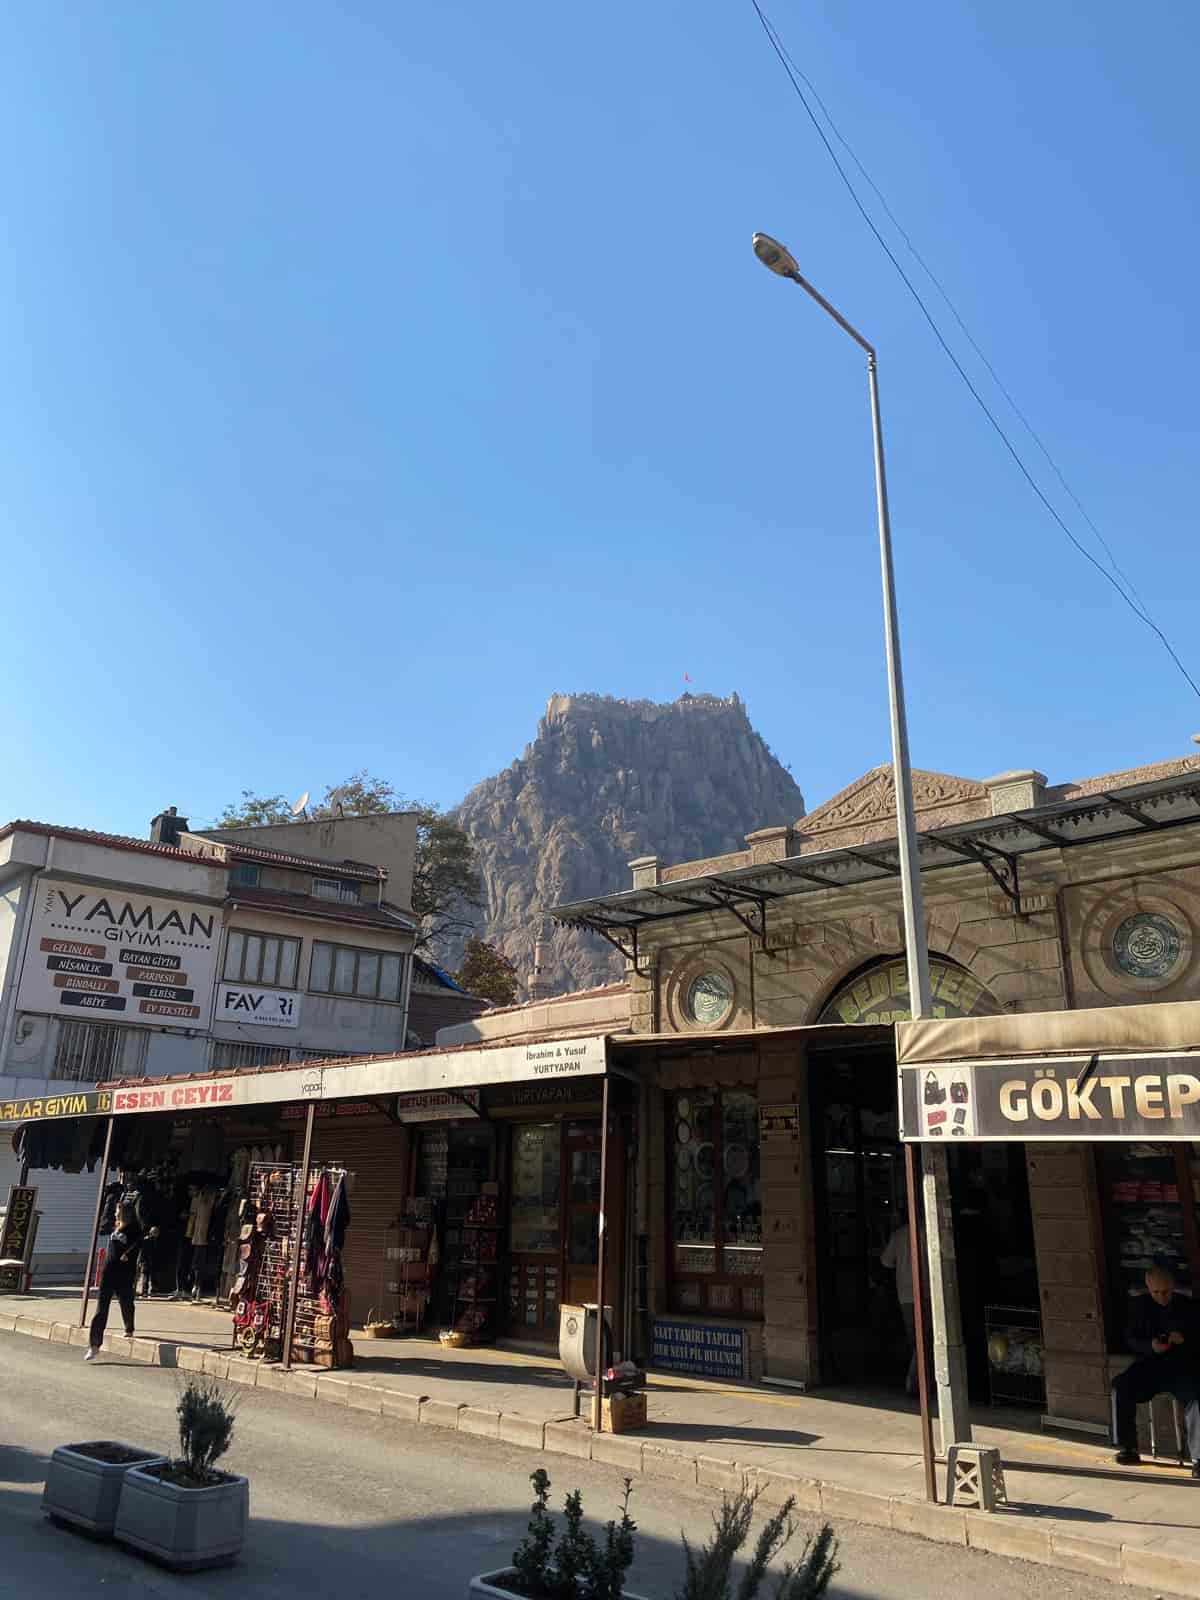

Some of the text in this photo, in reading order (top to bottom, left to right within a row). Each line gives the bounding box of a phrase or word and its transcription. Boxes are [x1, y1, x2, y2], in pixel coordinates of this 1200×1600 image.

[58, 890, 214, 939] YAMAN
[123, 952, 151, 964] BAYAN
[556, 1048, 562, 1057] &
[564, 1045, 586, 1057] Yusuf
[534, 1062, 581, 1074] YURTYAPAN
[115, 1091, 165, 1110] ESEN
[1000, 1069, 1200, 1121] GÖKTEP
